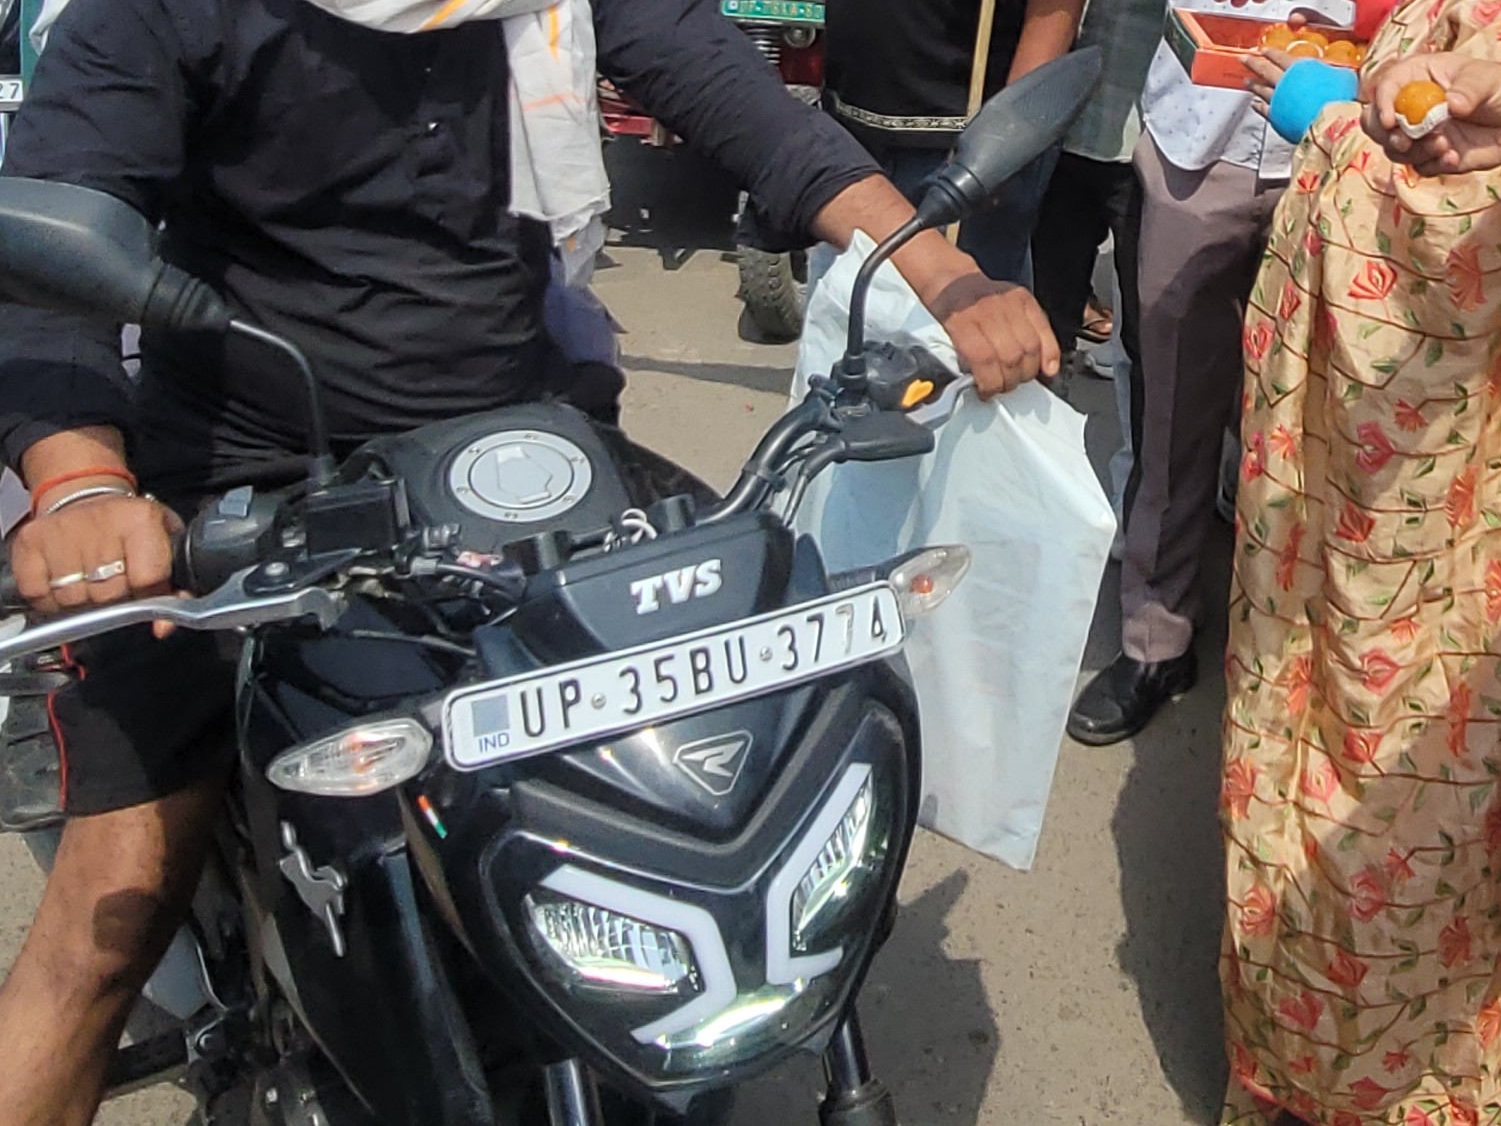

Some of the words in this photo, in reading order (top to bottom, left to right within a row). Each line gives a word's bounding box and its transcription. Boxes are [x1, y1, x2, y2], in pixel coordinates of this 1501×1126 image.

[629, 557, 723, 615] TVS
[518, 678, 583, 739] UP
[618, 636, 750, 716] 35BU
[477, 731, 511, 754] IND
